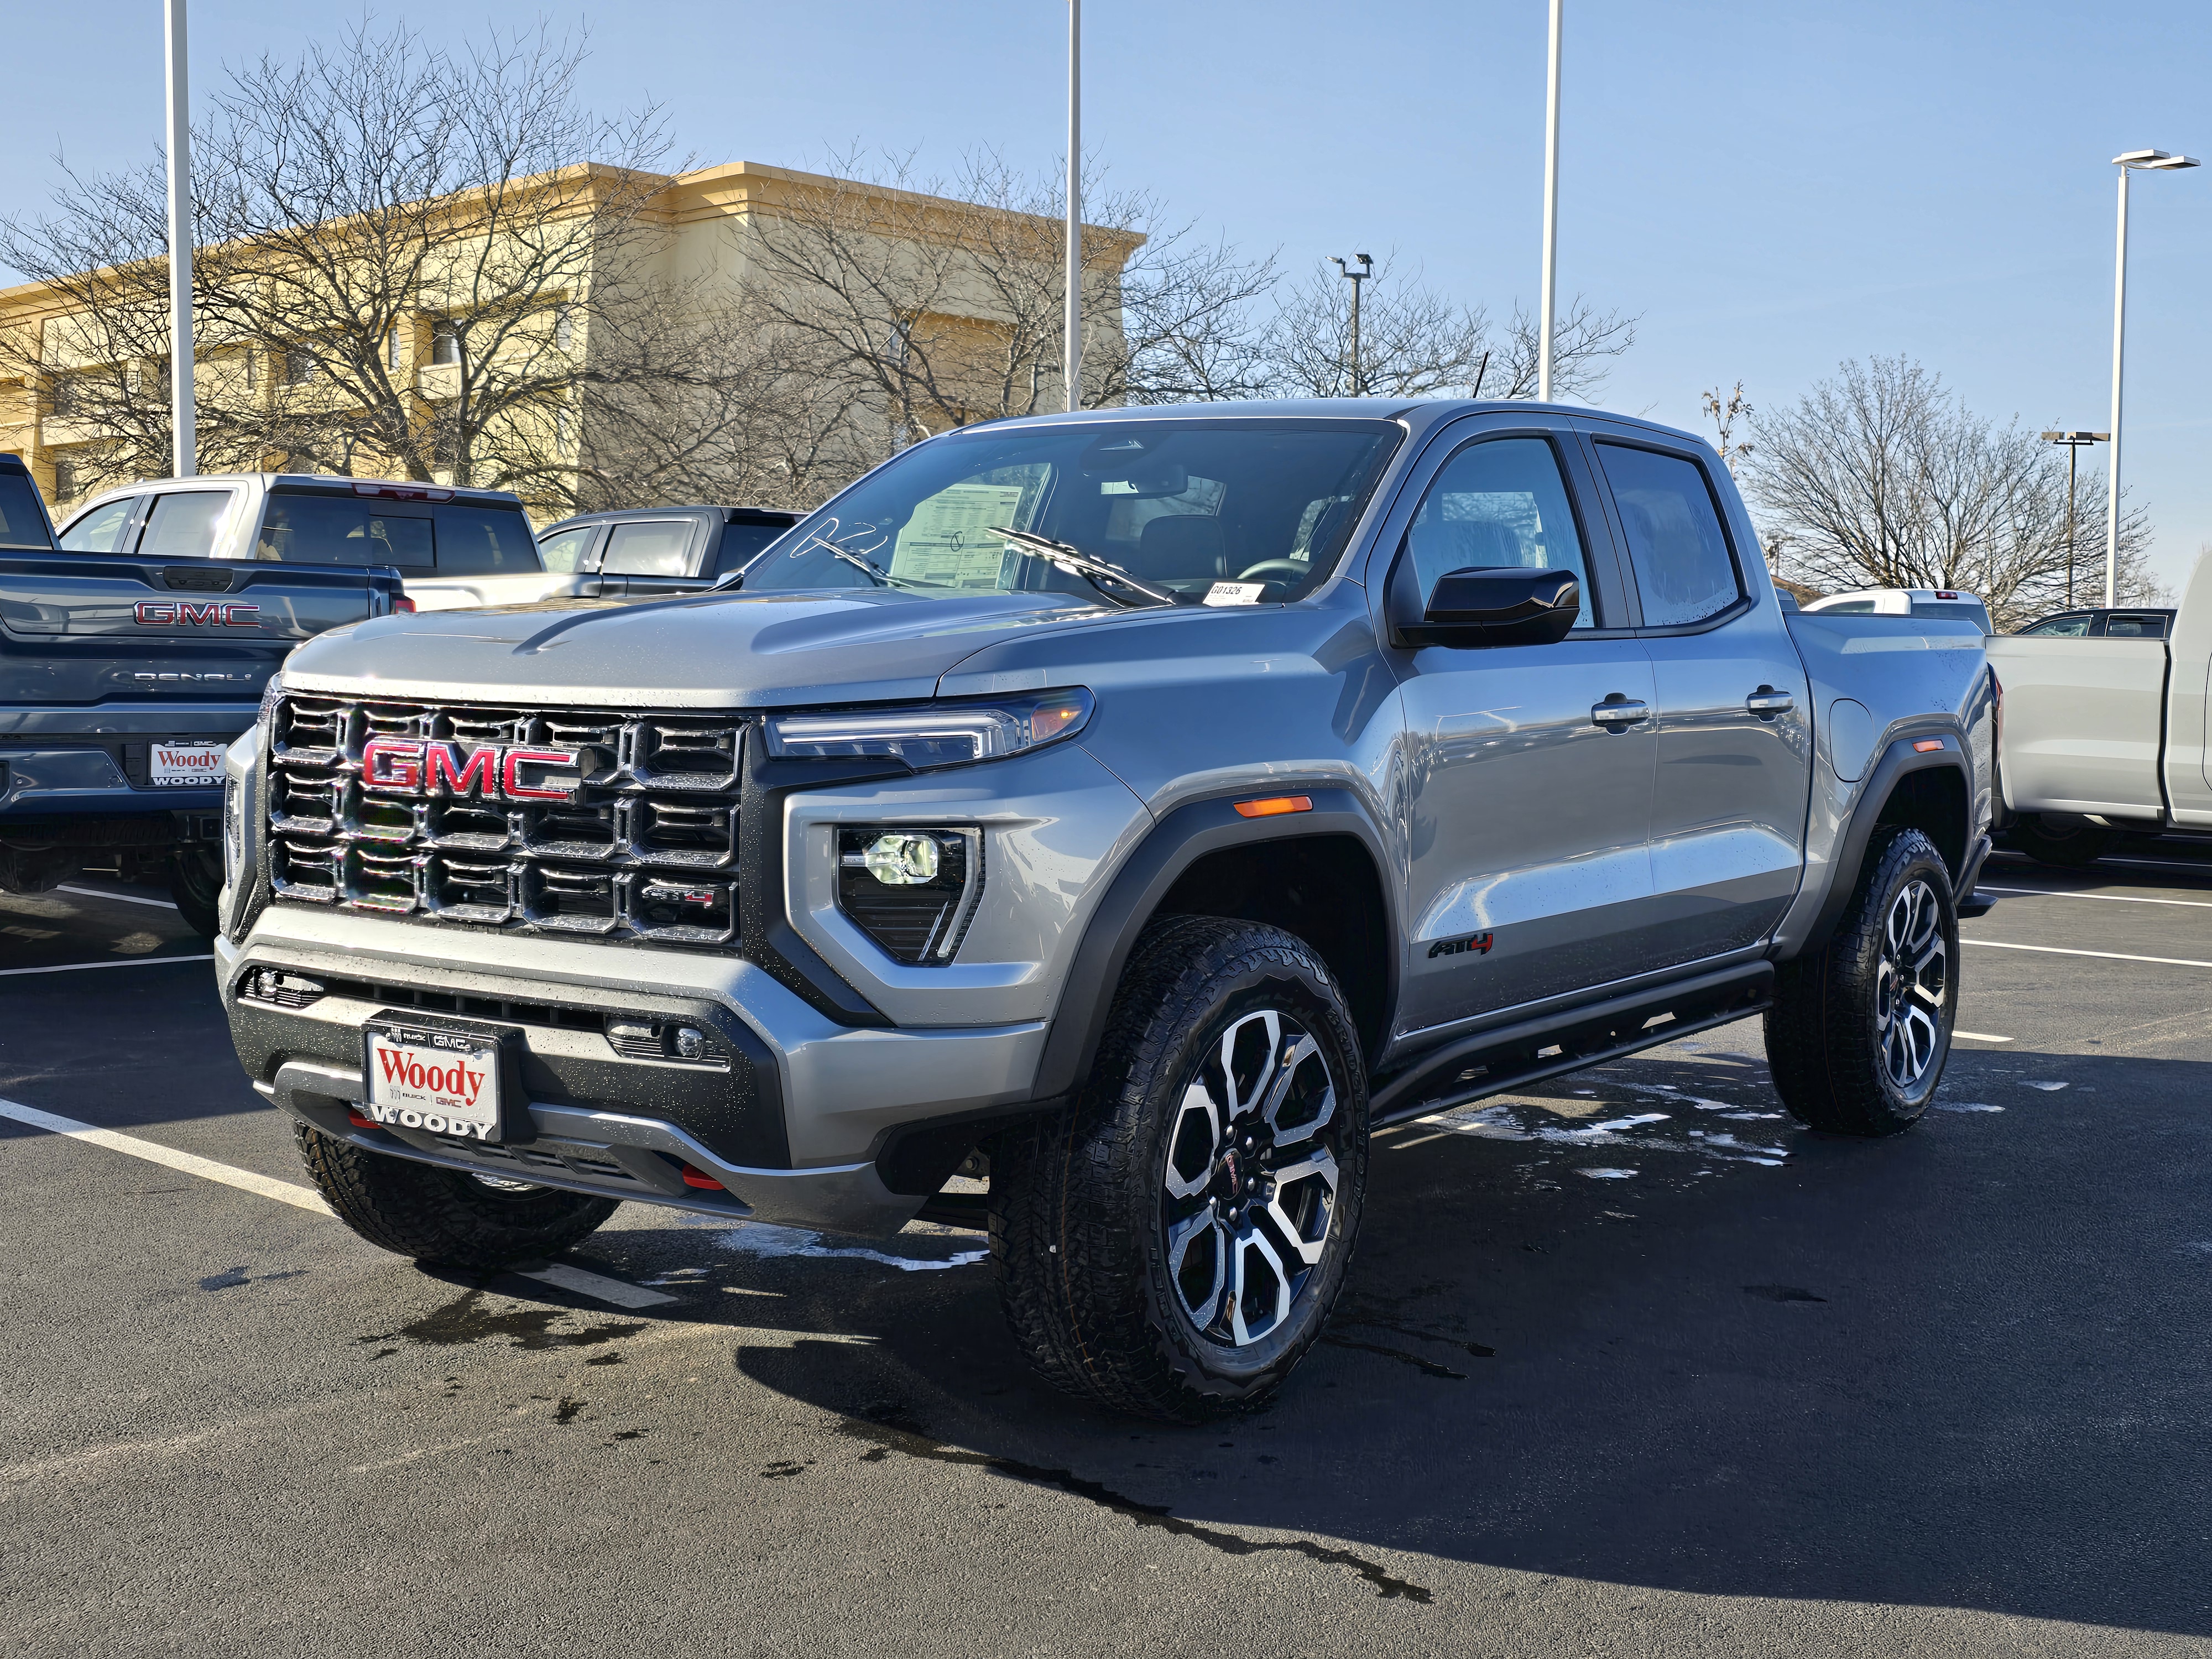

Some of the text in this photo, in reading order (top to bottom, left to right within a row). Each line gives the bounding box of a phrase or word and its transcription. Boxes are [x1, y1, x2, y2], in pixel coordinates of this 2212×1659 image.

[134, 602, 260, 627] GMC
[158, 751, 221, 770] Woody
[363, 738, 578, 804] GMC
[152, 776, 225, 785] WOODY
[1428, 933, 1493, 958] AT4
[433, 1035, 471, 1049] GMC
[377, 1048, 486, 1106] Woody
[436, 1097, 462, 1108] GMC
[370, 1106, 493, 1140] WOODY
